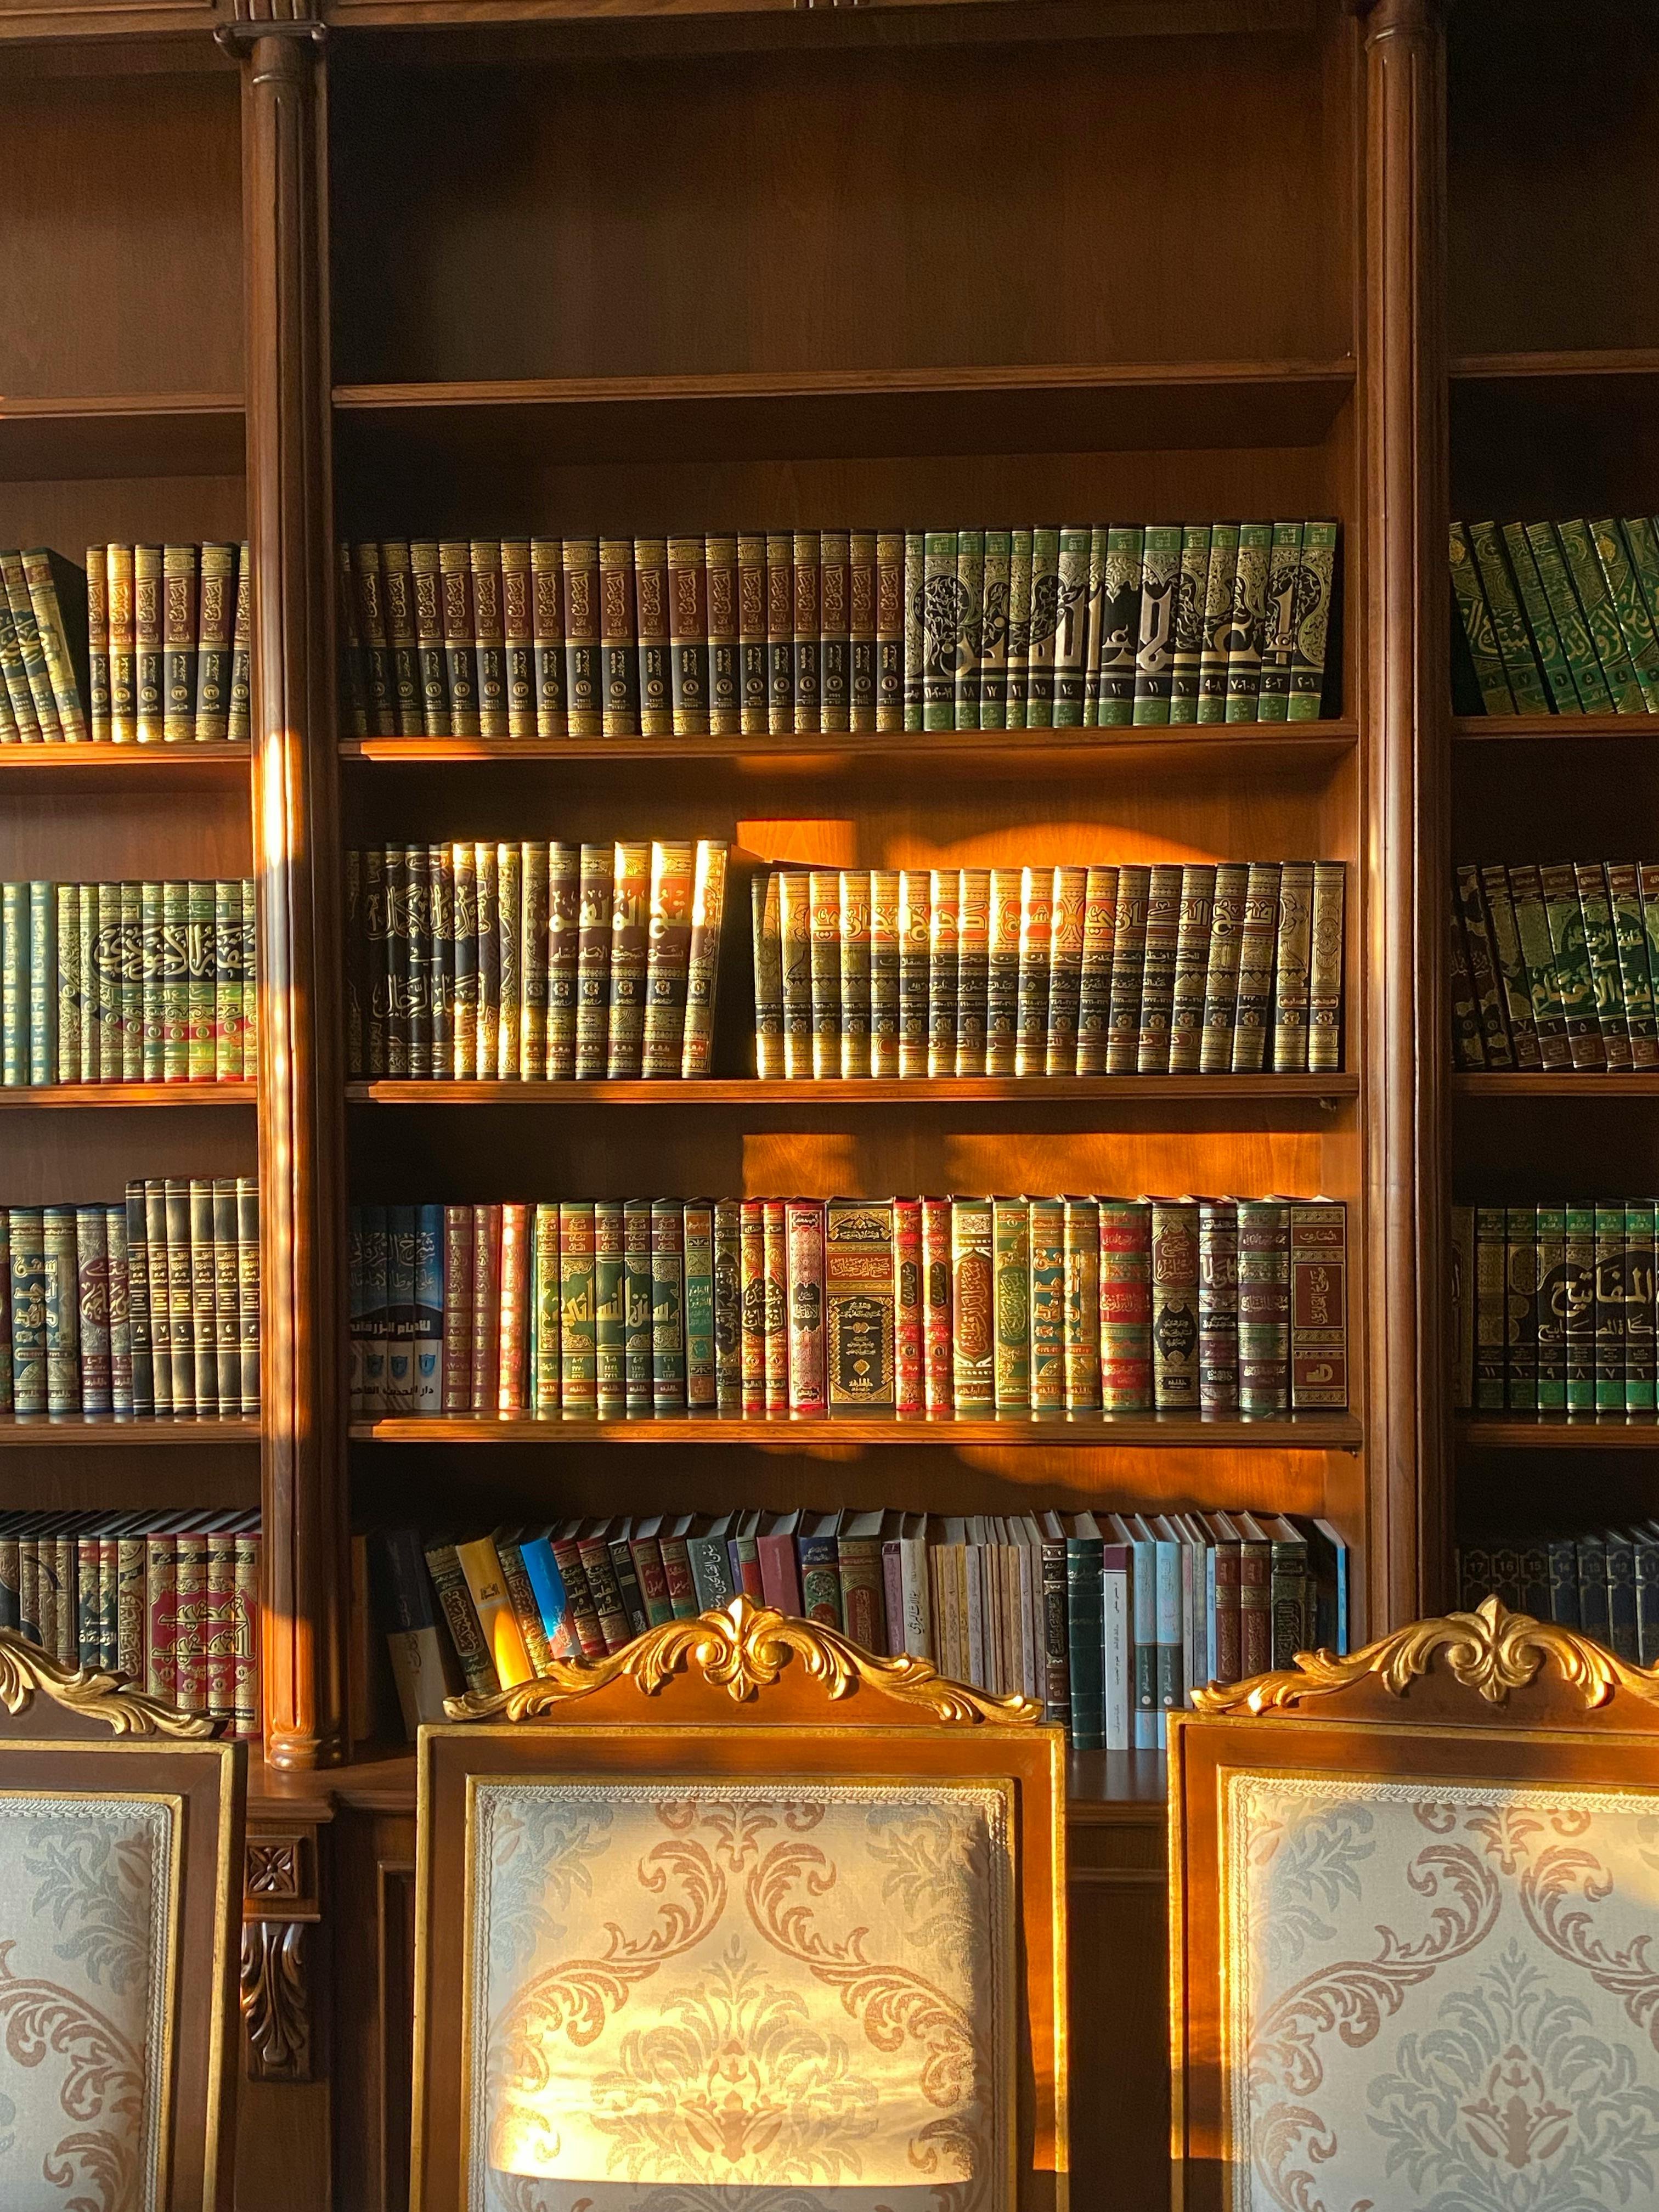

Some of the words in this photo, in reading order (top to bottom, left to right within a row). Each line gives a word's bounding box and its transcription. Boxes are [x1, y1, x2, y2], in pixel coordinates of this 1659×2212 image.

[962, 685, 974, 697] ١٨
[986, 685, 997, 697] ١٧
[1035, 683, 1046, 696] ١٥
[1062, 683, 1074, 696] ١٤
[1148, 681, 1159, 693] ١١
[1547, 1023, 1556, 1032] ٦
[1579, 1023, 1587, 1032] ٥
[1611, 1023, 1619, 1034] ٤
[1638, 1022, 1646, 1034] ٣
[1299, 1230, 1337, 1243] البخاري
[1551, 1266, 1654, 1317] المفاتيح
[160, 1325, 166, 1333] ٧
[1538, 1318, 1617, 1342] المصابيح
[1485, 1367, 1496, 1377] ١١
[1546, 1368, 1554, 1379] ٩
[1576, 1369, 1585, 1379] ٨
[1606, 1368, 1615, 1379] ٧
[1637, 1368, 1645, 1379] ٦
[419, 1384, 435, 1397] دار
[1470, 1561, 1483, 1572] 17
[1500, 1561, 1514, 1572] 16
[1528, 1561, 1541, 1571] 15
[1559, 1562, 1570, 1573] 14
[568, 1585, 588, 1599] العلم
[594, 1583, 619, 1599] العلم
[605, 1596, 612, 1605] و
[597, 1602, 623, 1616] فضله
